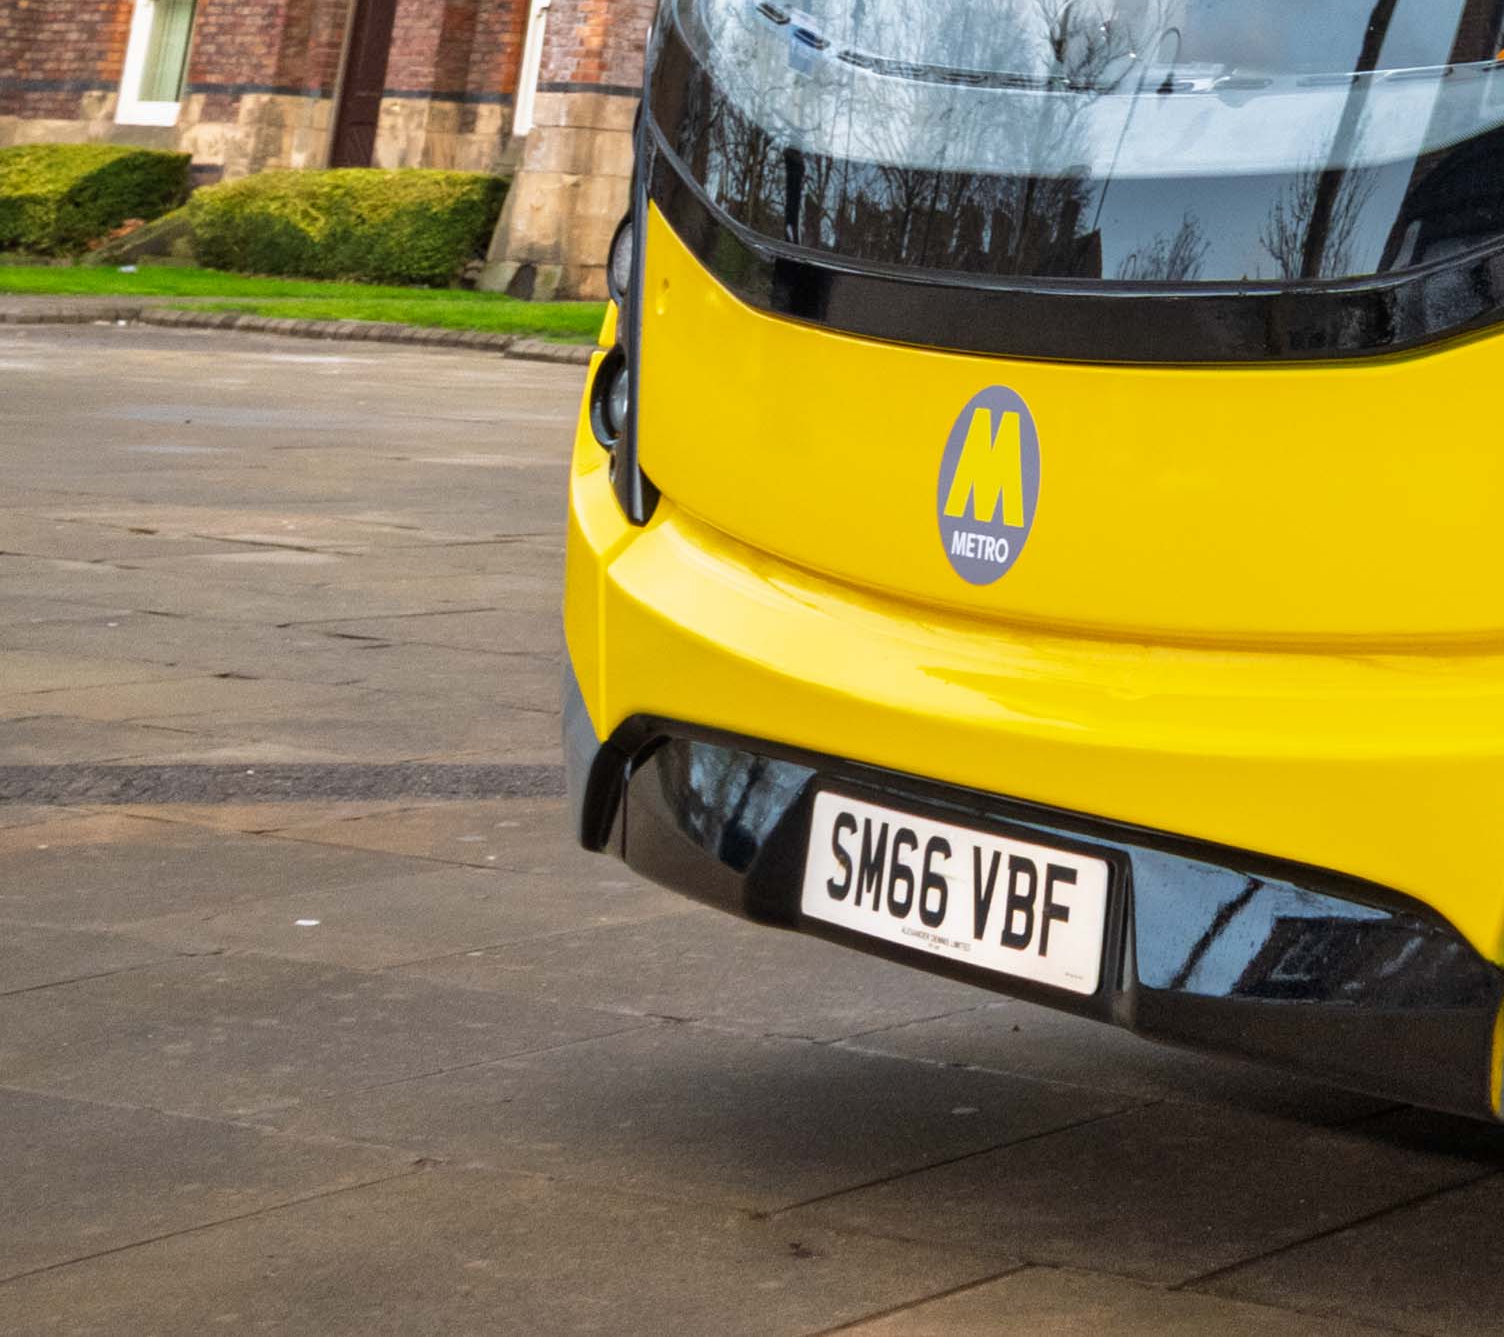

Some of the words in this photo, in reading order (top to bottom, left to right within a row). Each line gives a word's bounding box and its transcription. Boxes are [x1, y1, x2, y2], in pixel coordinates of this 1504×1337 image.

[943, 407, 1025, 528] M
[951, 529, 1010, 565] METRO
[827, 811, 952, 928] SM66
[972, 846, 1079, 958] VBF
